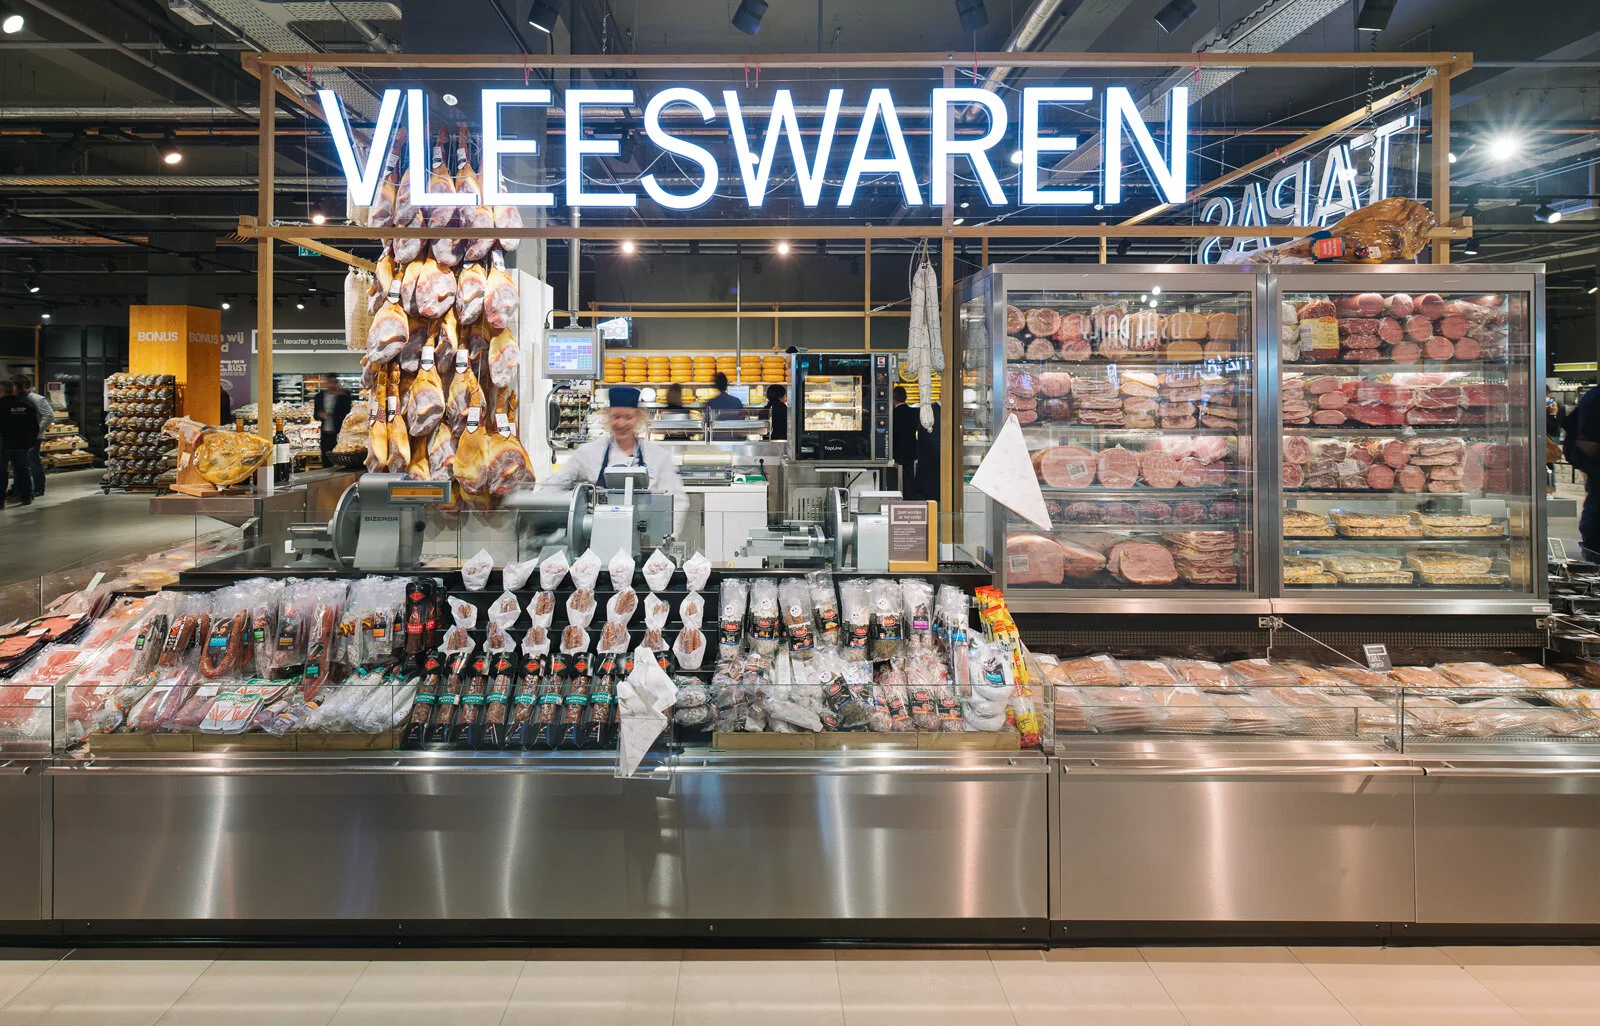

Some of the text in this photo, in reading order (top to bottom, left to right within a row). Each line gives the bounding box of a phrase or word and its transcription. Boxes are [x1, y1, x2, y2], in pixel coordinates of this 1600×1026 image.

[317, 87, 1190, 210] VLEESWAREN
[137, 331, 179, 342] BONUS
[188, 331, 219, 345] BONUS
[226, 331, 245, 345] wij
[310, 338, 318, 346] ligt
[227, 364, 247, 372] RUST
